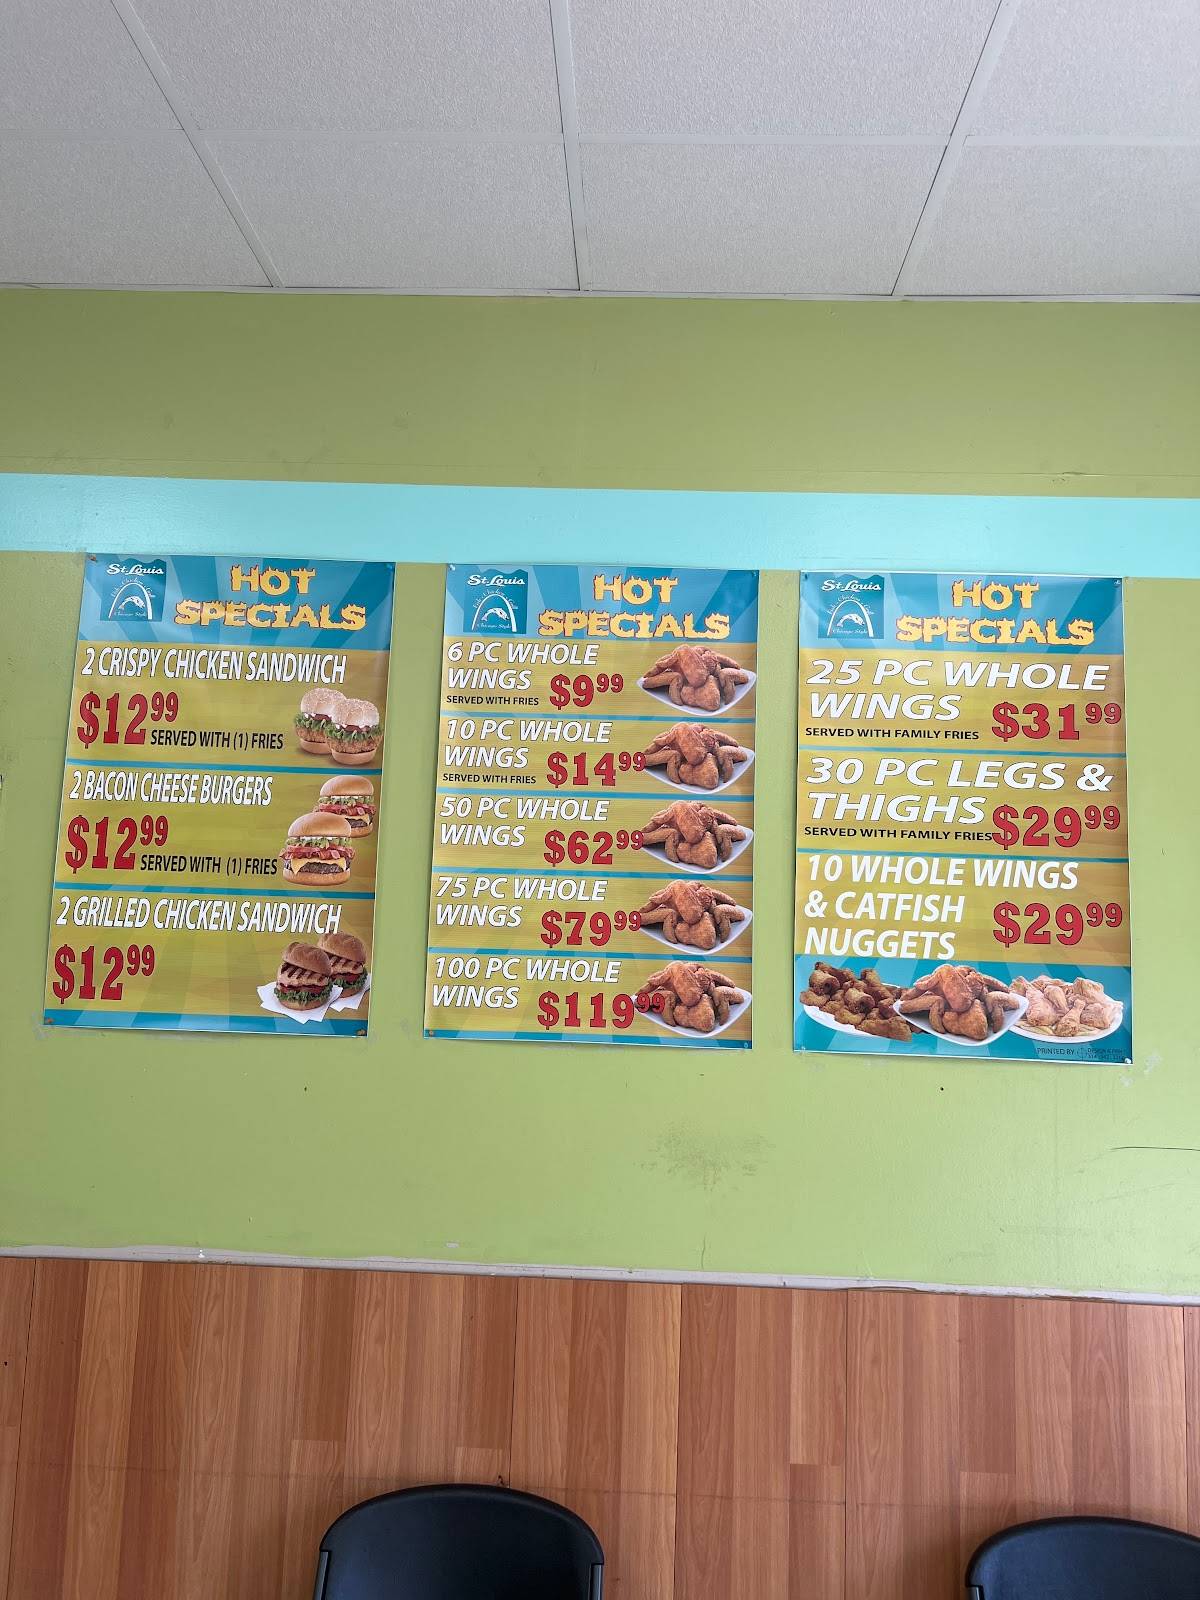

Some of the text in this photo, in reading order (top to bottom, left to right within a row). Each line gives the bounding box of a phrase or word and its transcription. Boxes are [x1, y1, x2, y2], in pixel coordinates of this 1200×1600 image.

[125, 564, 163, 576] Louis
[230, 565, 316, 595] HOT
[486, 575, 525, 586] Louis
[593, 574, 678, 605] HOT
[841, 580, 881, 592] Louis
[952, 580, 1040, 611] HOT
[175, 600, 367, 631] SPECIALS
[538, 610, 730, 639] SPECIALS
[896, 615, 1095, 646] SPECIALS
[81, 647, 347, 684] 2 CRISPY CHICKEN SANDWICH
[448, 642, 599, 665] 6 PC WHOLE
[447, 668, 531, 690] WINGS
[806, 659, 1110, 690] 25 PC WHOLE
[446, 695, 539, 706] SERVED WITH FRIES
[810, 693, 962, 721] WINGS
[151, 730, 284, 750] SERVED WITH (1) FRIES
[446, 719, 612, 743] 10 PC WHOLE
[805, 727, 979, 740] SERVED WITH FAMILY FRIES
[444, 746, 529, 768] WINGS
[443, 773, 536, 784] SERVED WITH FRIES
[806, 757, 1114, 792] 30 PC LEGS &
[69, 771, 273, 805] 2 BACON CHEESE BURGERS
[439, 797, 610, 821] 50 PC WHOLE
[807, 792, 988, 824] THIGHS
[440, 824, 525, 846] WINGS
[804, 827, 993, 841] SERVED WITH FAMILY FRIES
[140, 854, 277, 876] SERVED WITH (1) FRIES
[808, 855, 1079, 889] 10 WHOLE WINGS
[436, 877, 608, 901] 75 PC WHOLE
[56, 896, 342, 934] 2 GRILLED CHICKEN SANDWICH
[436, 904, 522, 927] WINGS
[804, 891, 965, 922] & CATFISH
[804, 927, 956, 959] NUGGETS
[434, 957, 621, 983] 100 PC WHOLE
[432, 985, 519, 1008] WINGS
